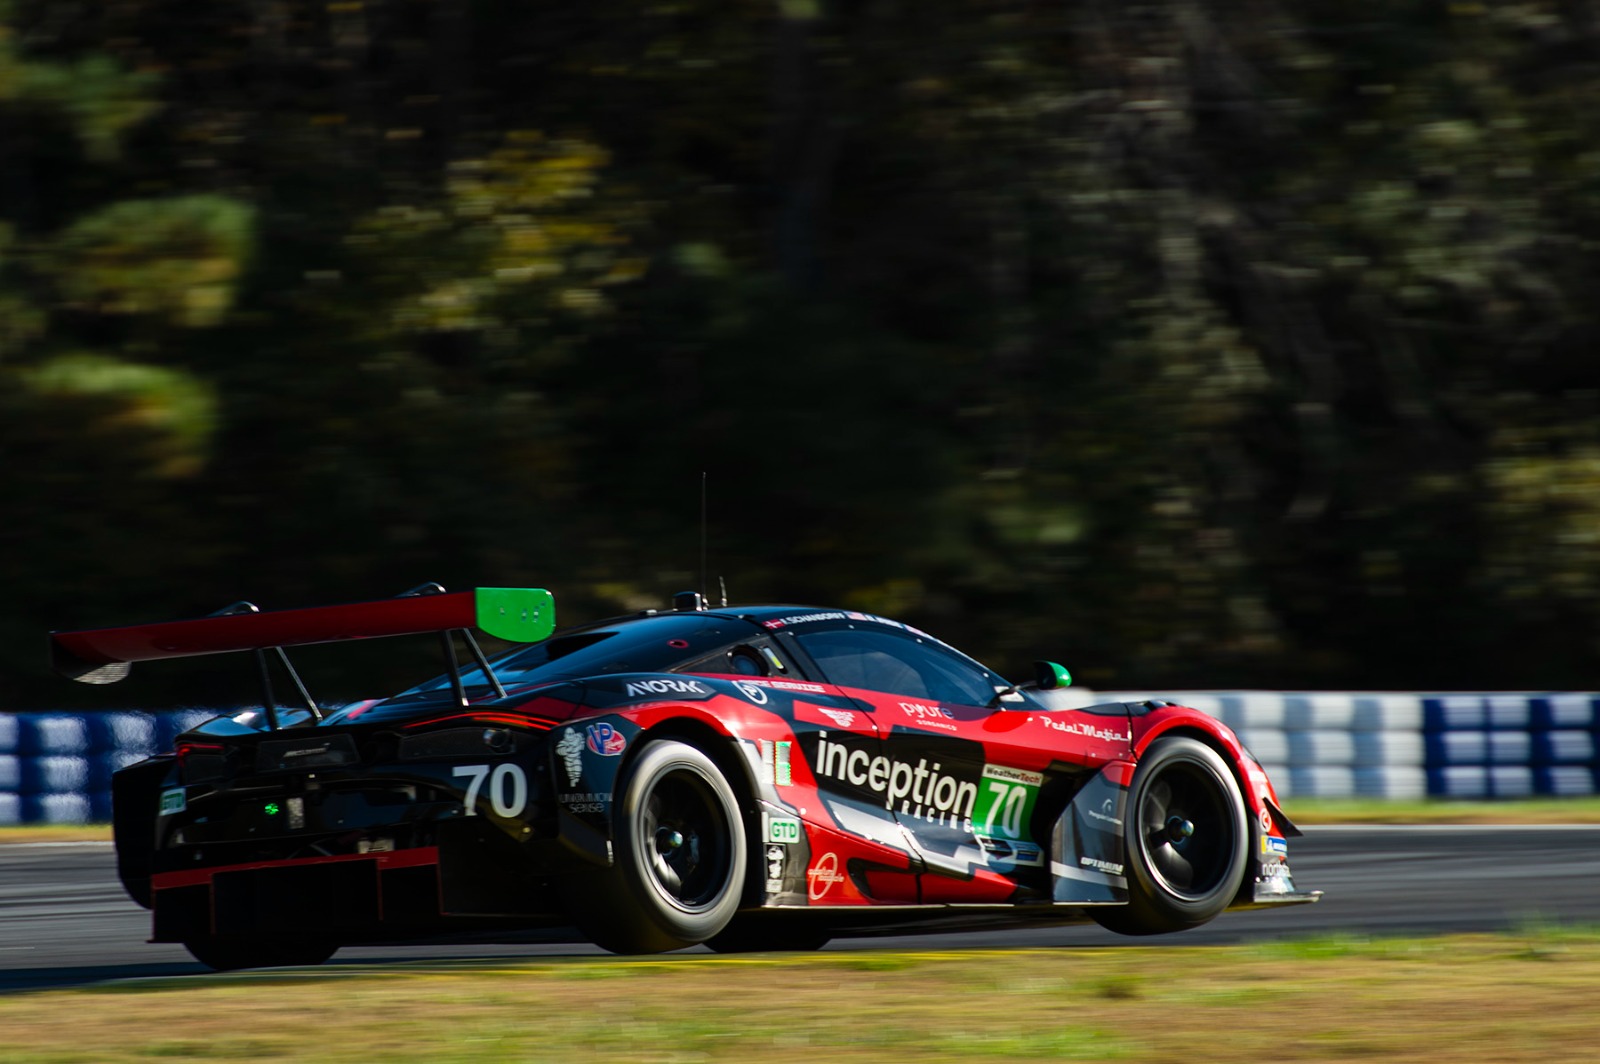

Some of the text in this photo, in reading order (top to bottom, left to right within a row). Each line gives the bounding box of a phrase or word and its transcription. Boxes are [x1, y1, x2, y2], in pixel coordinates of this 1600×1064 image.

[452, 763, 527, 818] 70
[815, 730, 978, 818] inception
[771, 822, 798, 838] GTD
[985, 781, 1027, 839] 70
